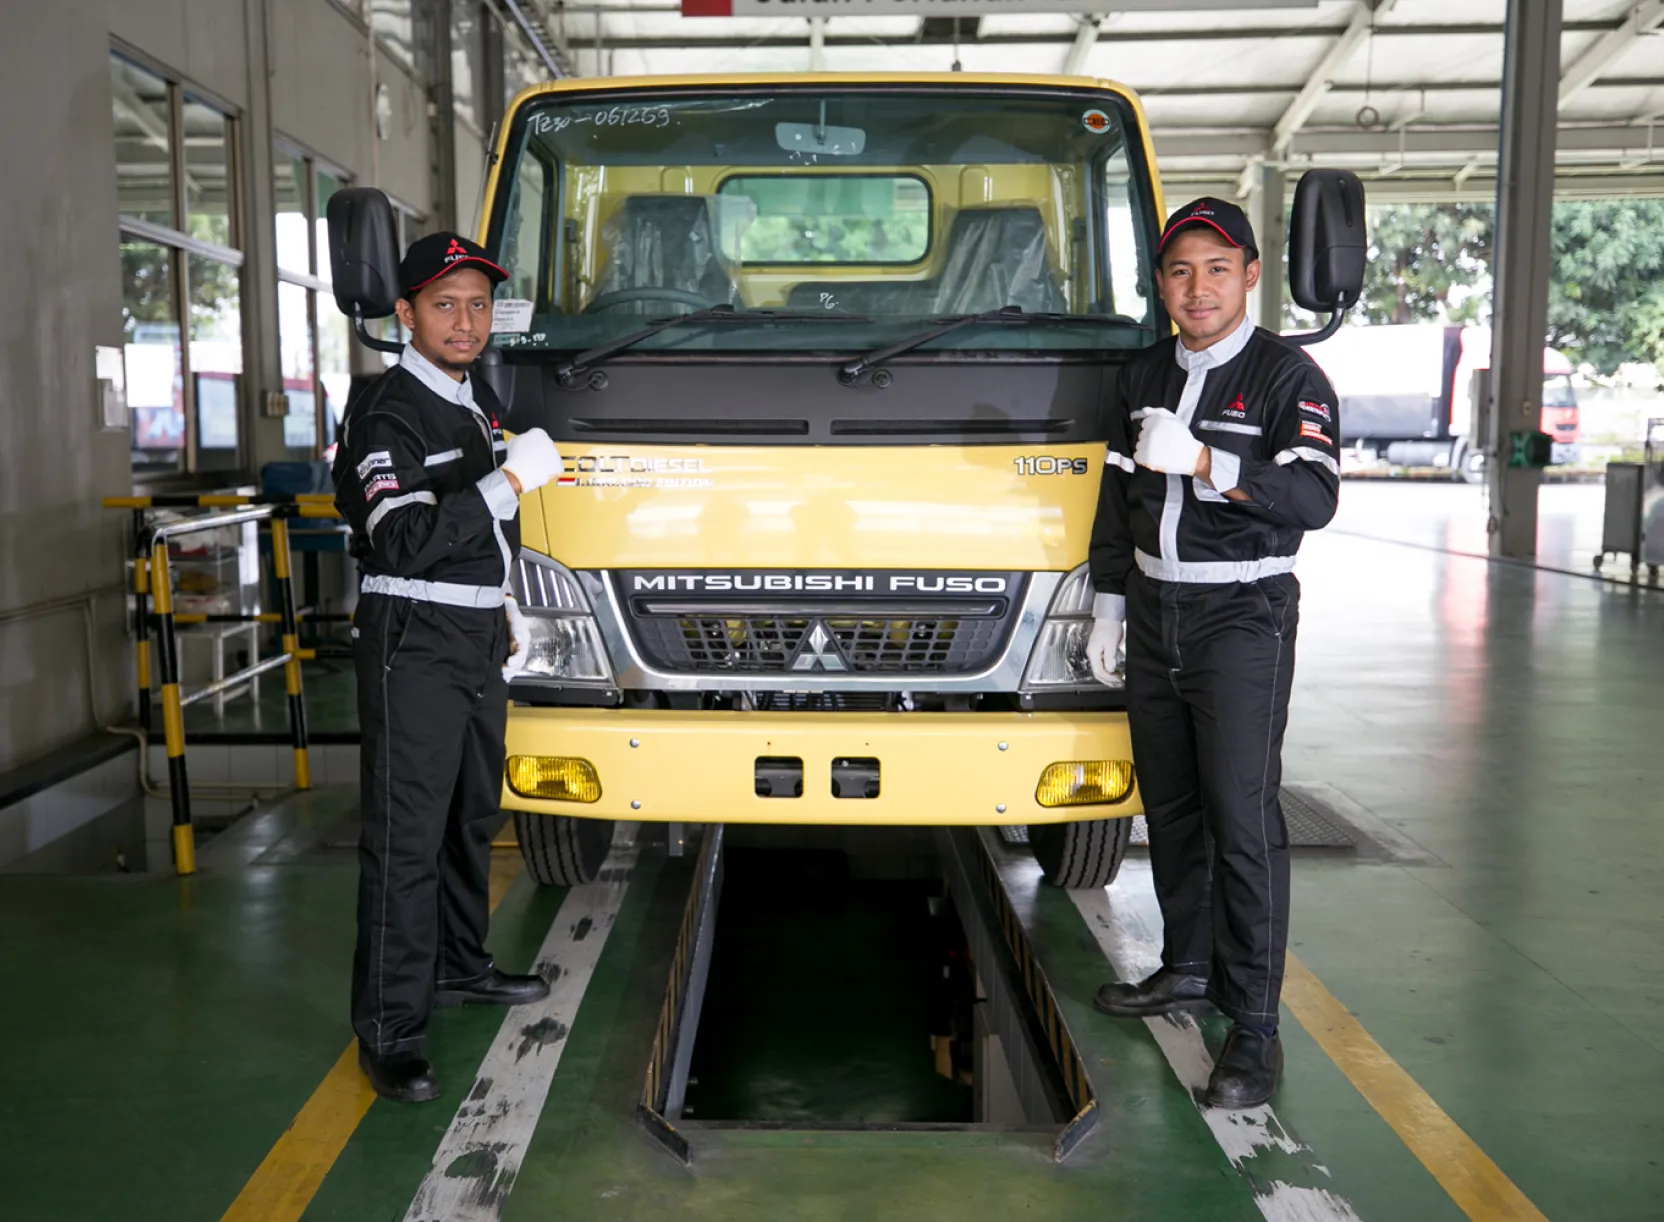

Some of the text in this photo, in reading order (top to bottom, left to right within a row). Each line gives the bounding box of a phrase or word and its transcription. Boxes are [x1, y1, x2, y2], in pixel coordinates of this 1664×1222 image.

[1222, 409, 1246, 418] FUSO
[630, 458, 713, 473] DIESEL
[1013, 456, 1088, 475] 110PS
[634, 575, 1007, 593] MITSUBISHI FUSO
